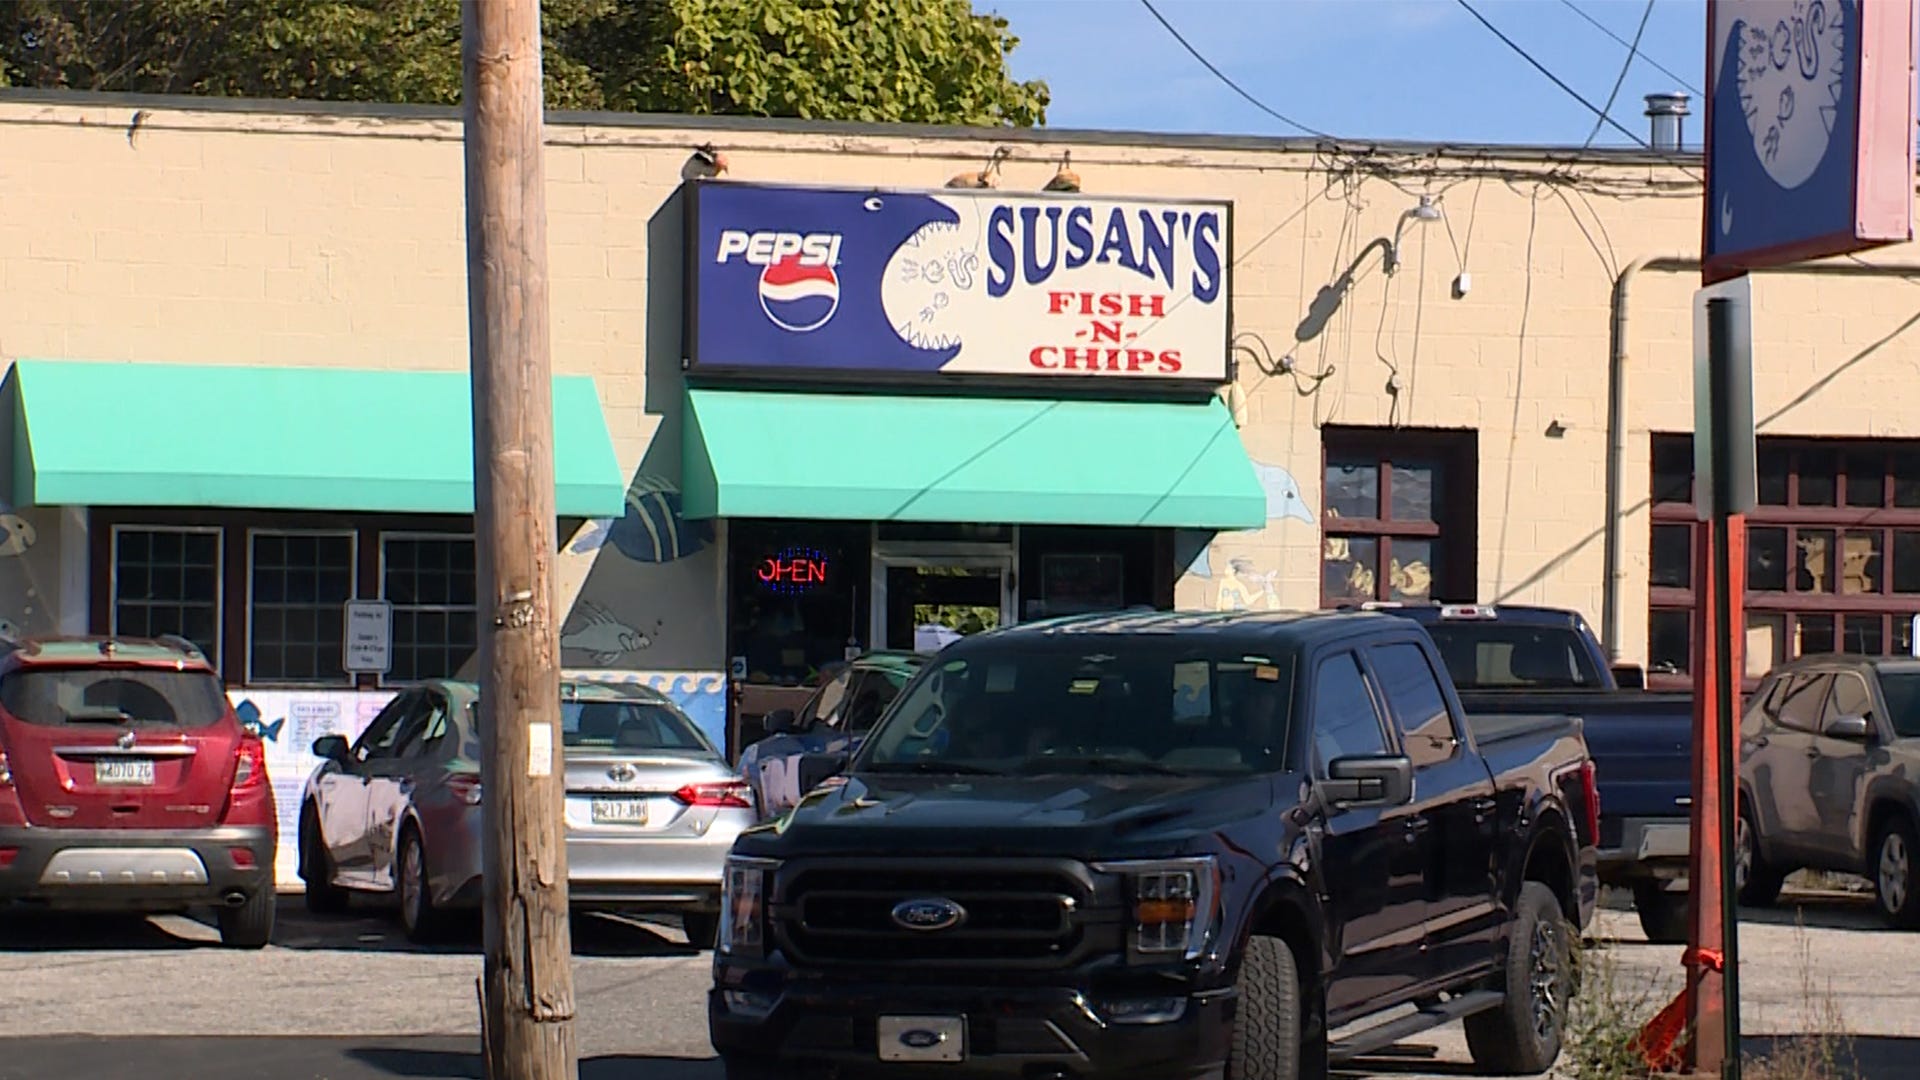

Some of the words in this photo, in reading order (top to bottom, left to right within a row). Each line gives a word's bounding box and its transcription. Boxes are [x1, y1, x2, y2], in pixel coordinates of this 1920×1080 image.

[716, 230, 843, 266] PEPSI
[987, 204, 1221, 305] SUSAN'S
[1047, 291, 1167, 318] FISH
[1075, 320, 1138, 344] -N-
[1029, 345, 1183, 373] CHIPS
[758, 558, 827, 582] OPEN
